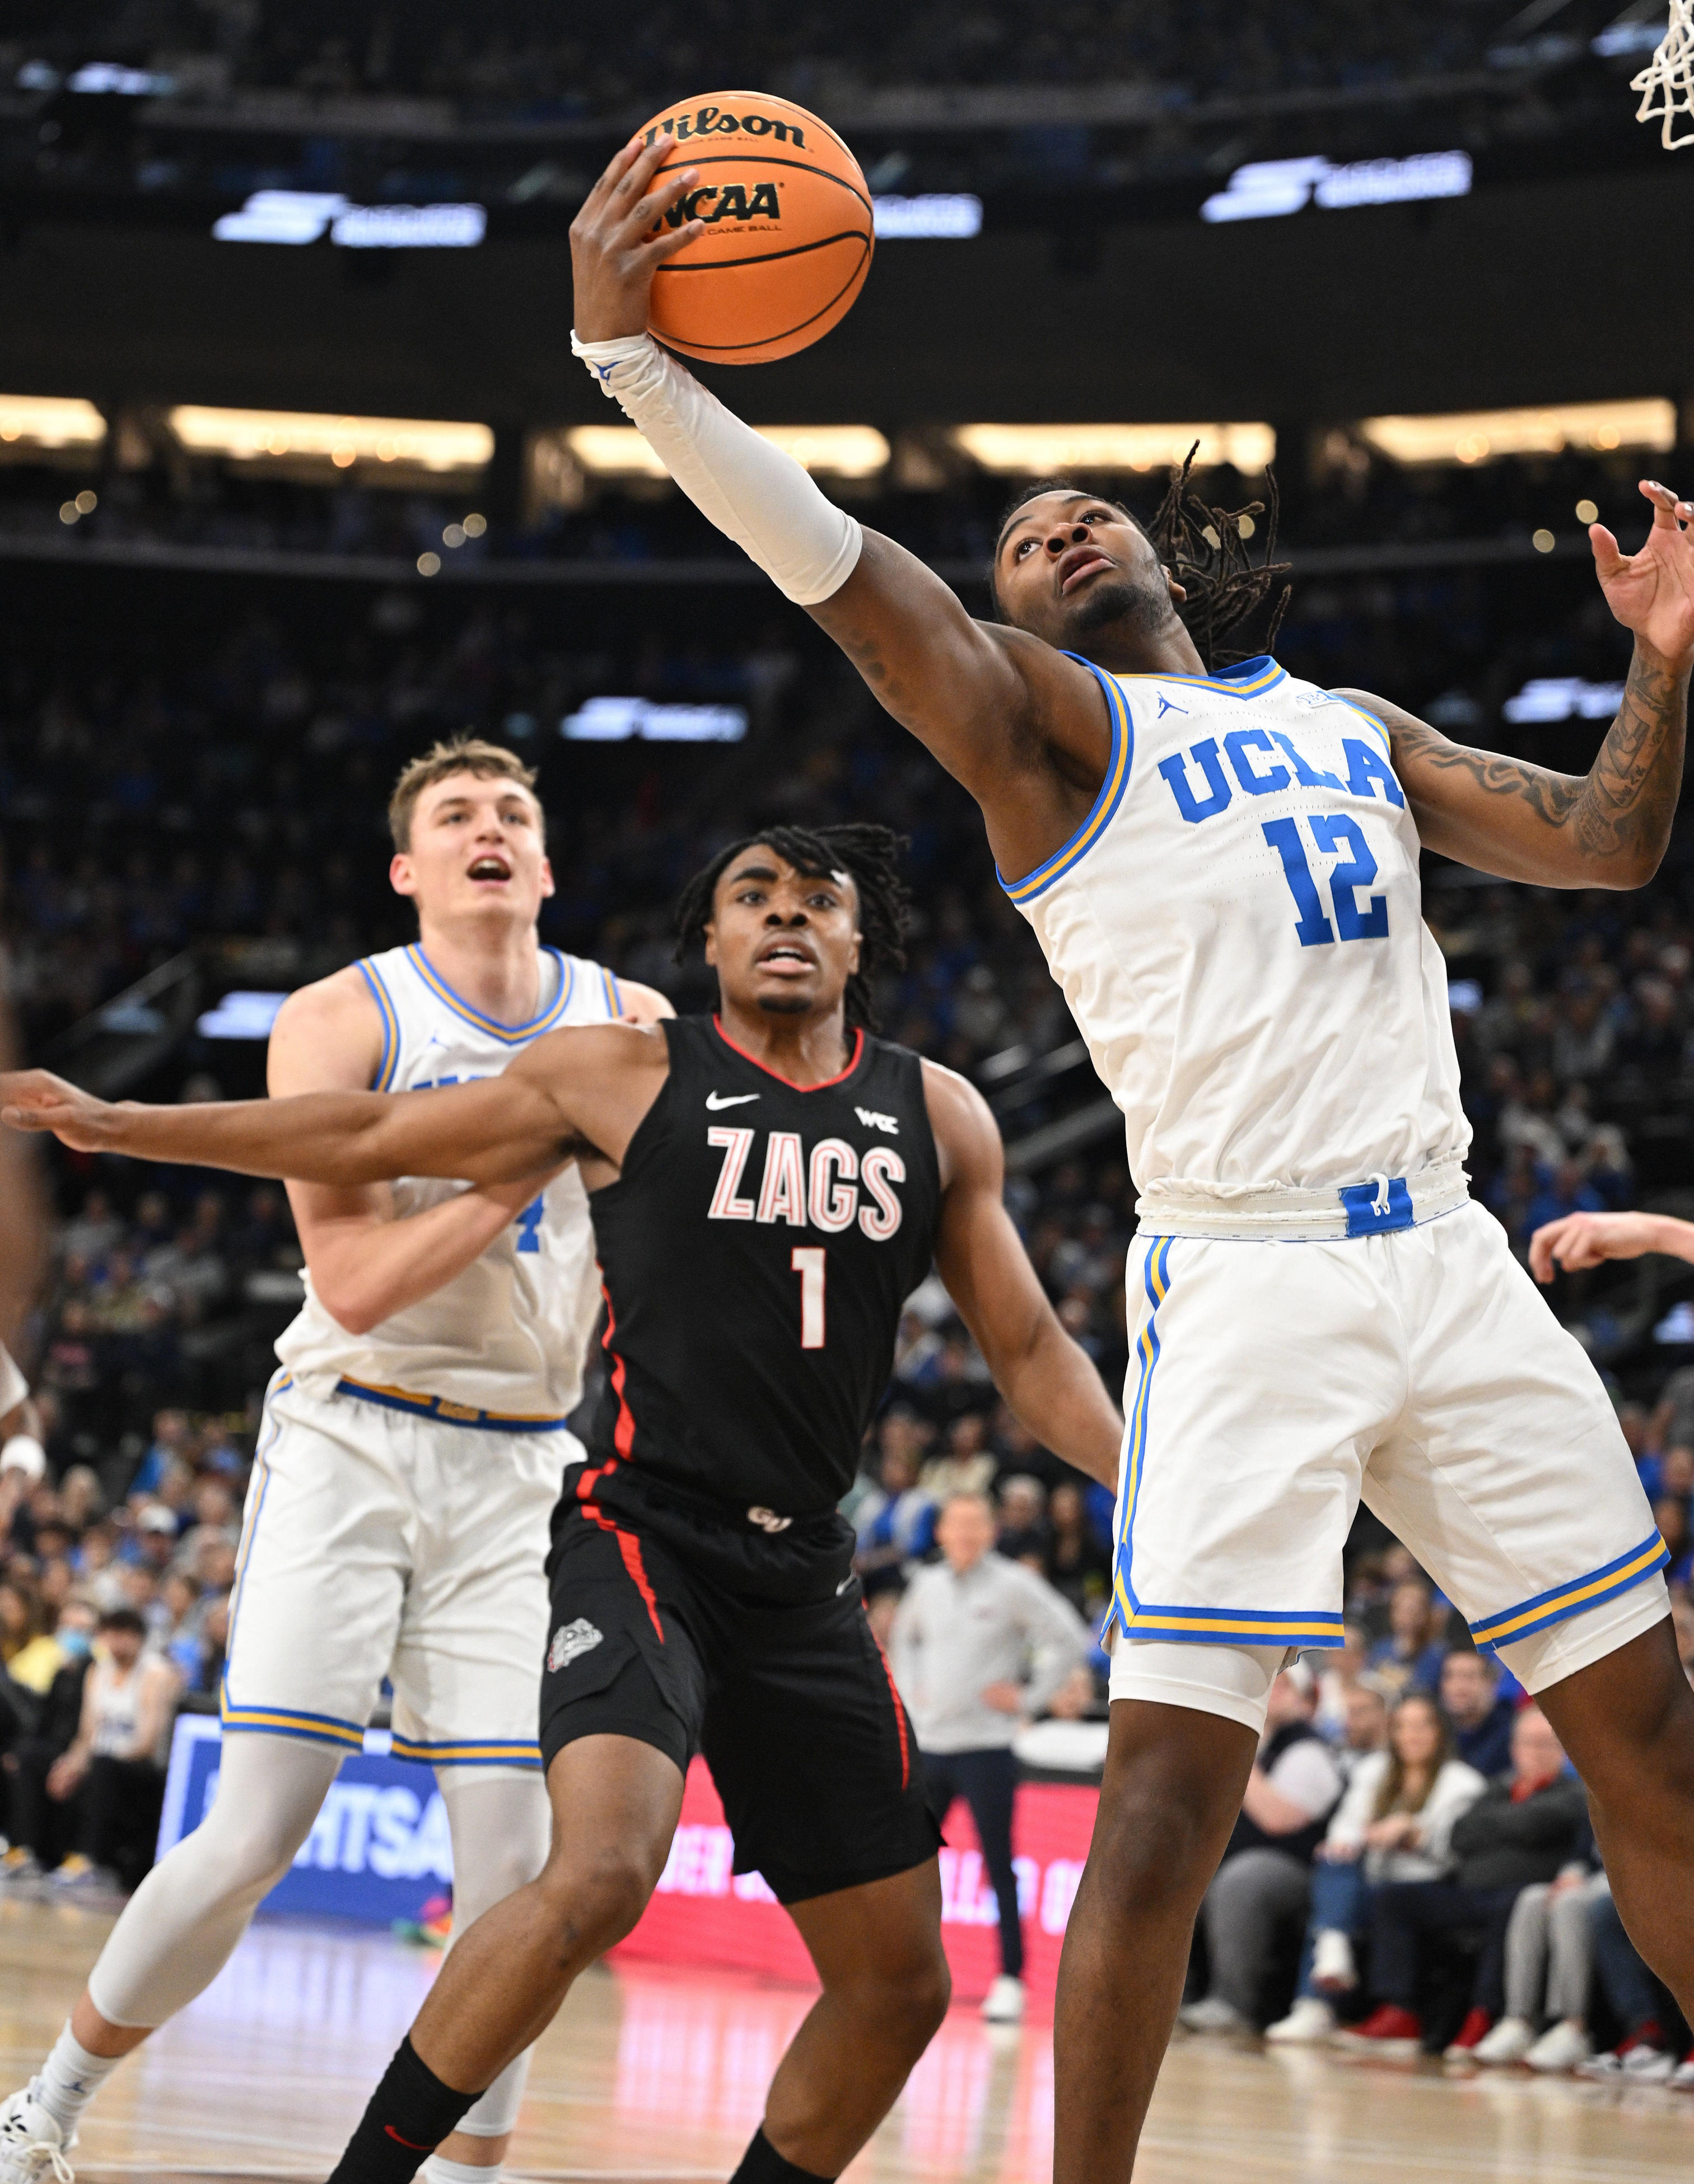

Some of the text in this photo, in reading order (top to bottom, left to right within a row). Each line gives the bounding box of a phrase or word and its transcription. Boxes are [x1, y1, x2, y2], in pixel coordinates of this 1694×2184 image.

[1158, 730, 1404, 824] UCLA
[1261, 814, 1389, 947] 12
[707, 1126, 906, 1241] ZAGS
[791, 1247, 826, 1349] 1
